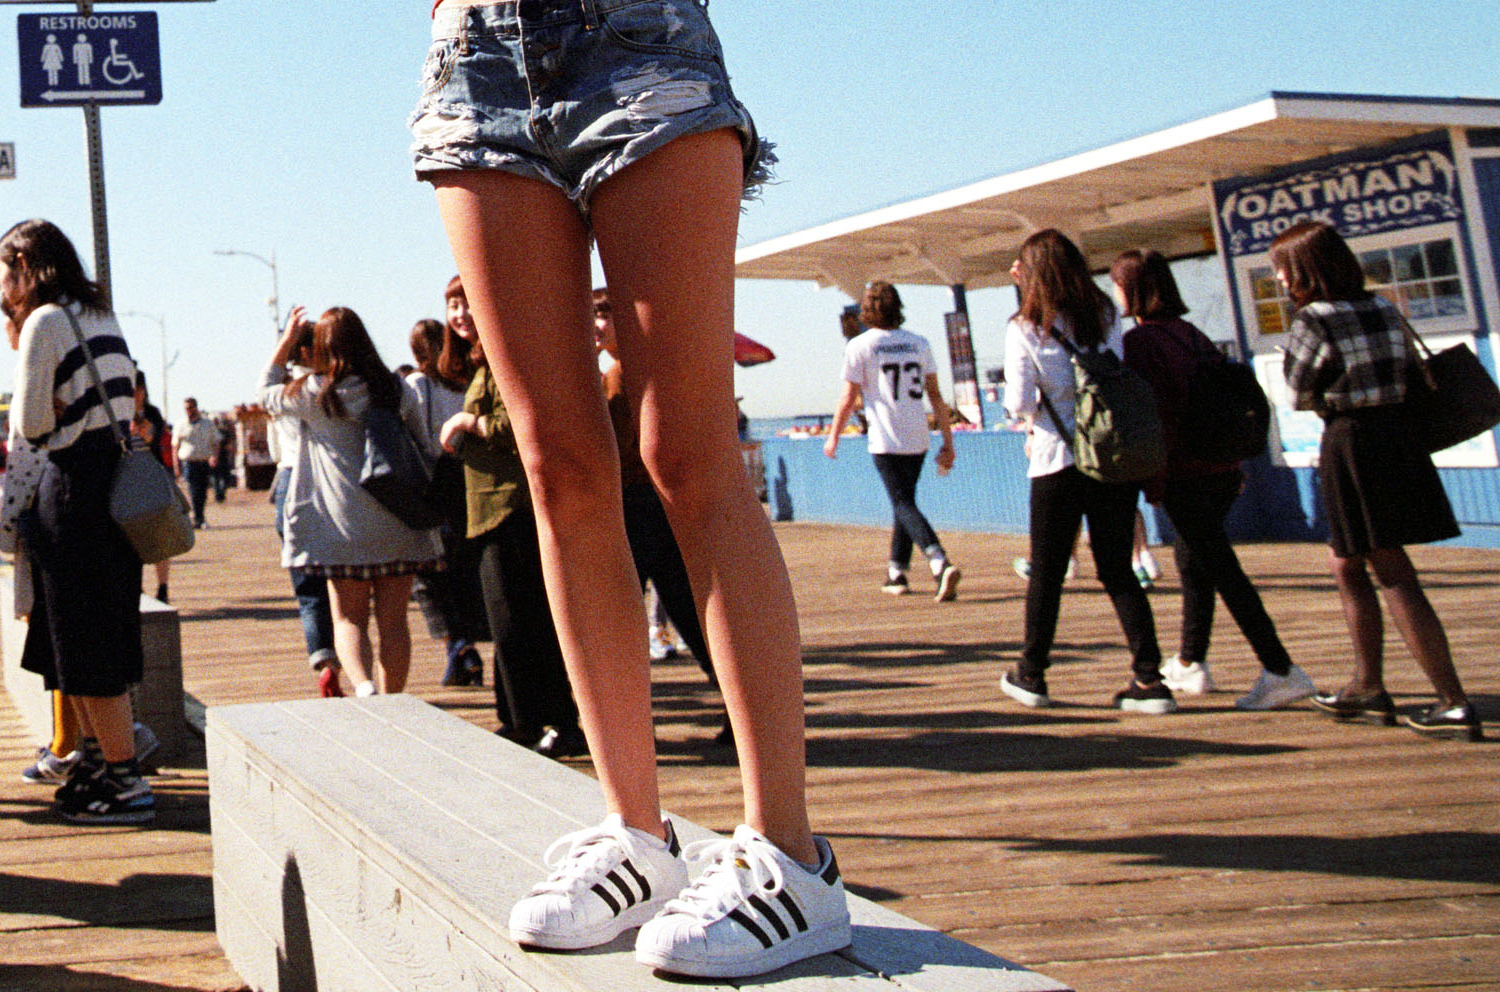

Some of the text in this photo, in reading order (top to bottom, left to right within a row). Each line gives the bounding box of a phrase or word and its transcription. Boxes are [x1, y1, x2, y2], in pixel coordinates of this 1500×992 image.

[40, 15, 137, 30] RESTROOMS
[1237, 160, 1434, 220] OATMAN
[1343, 191, 1434, 223] SHOP
[882, 362, 923, 401] 73
